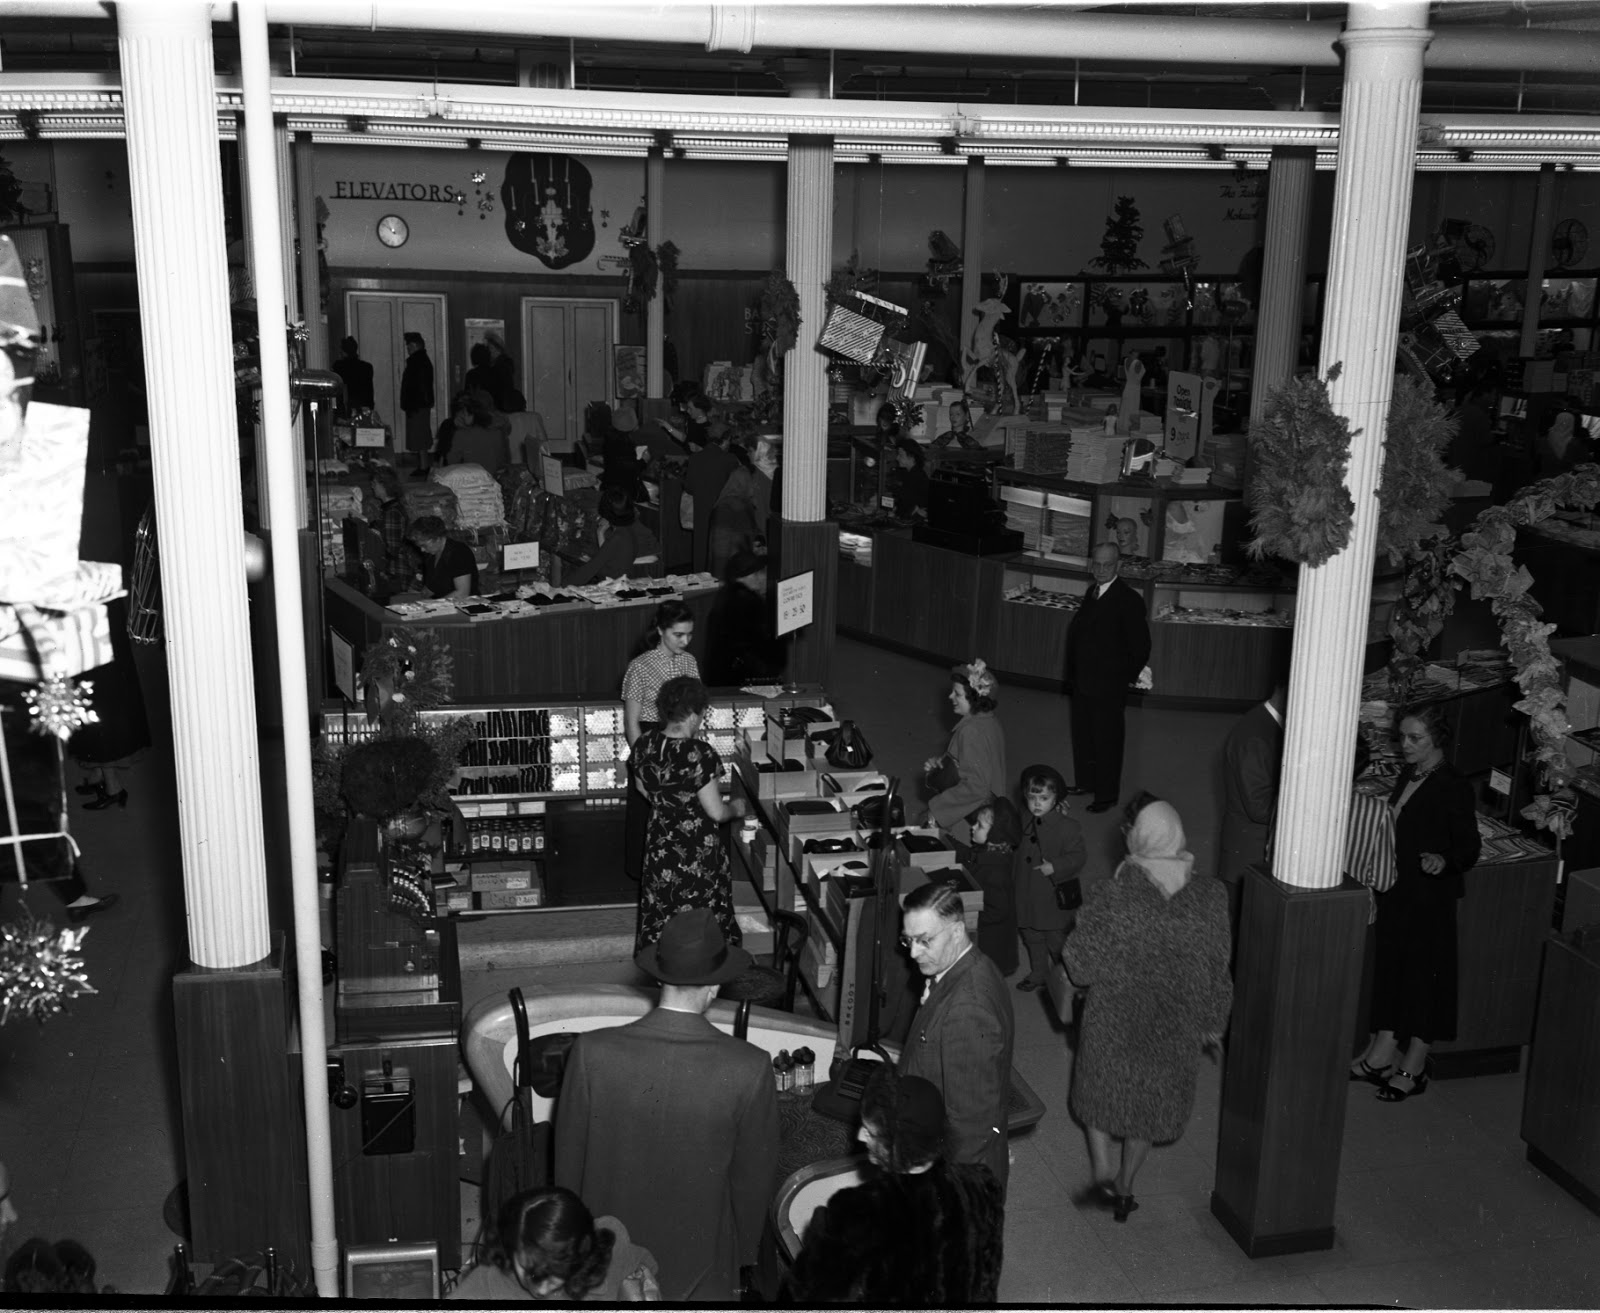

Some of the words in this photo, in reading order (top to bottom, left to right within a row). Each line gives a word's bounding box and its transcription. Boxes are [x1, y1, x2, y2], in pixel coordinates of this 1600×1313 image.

[335, 181, 455, 202] ELEVATORS
[1176, 384, 1191, 396] Open
[1170, 427, 1176, 441] 9
[844, 983, 855, 1026] HOOVER
